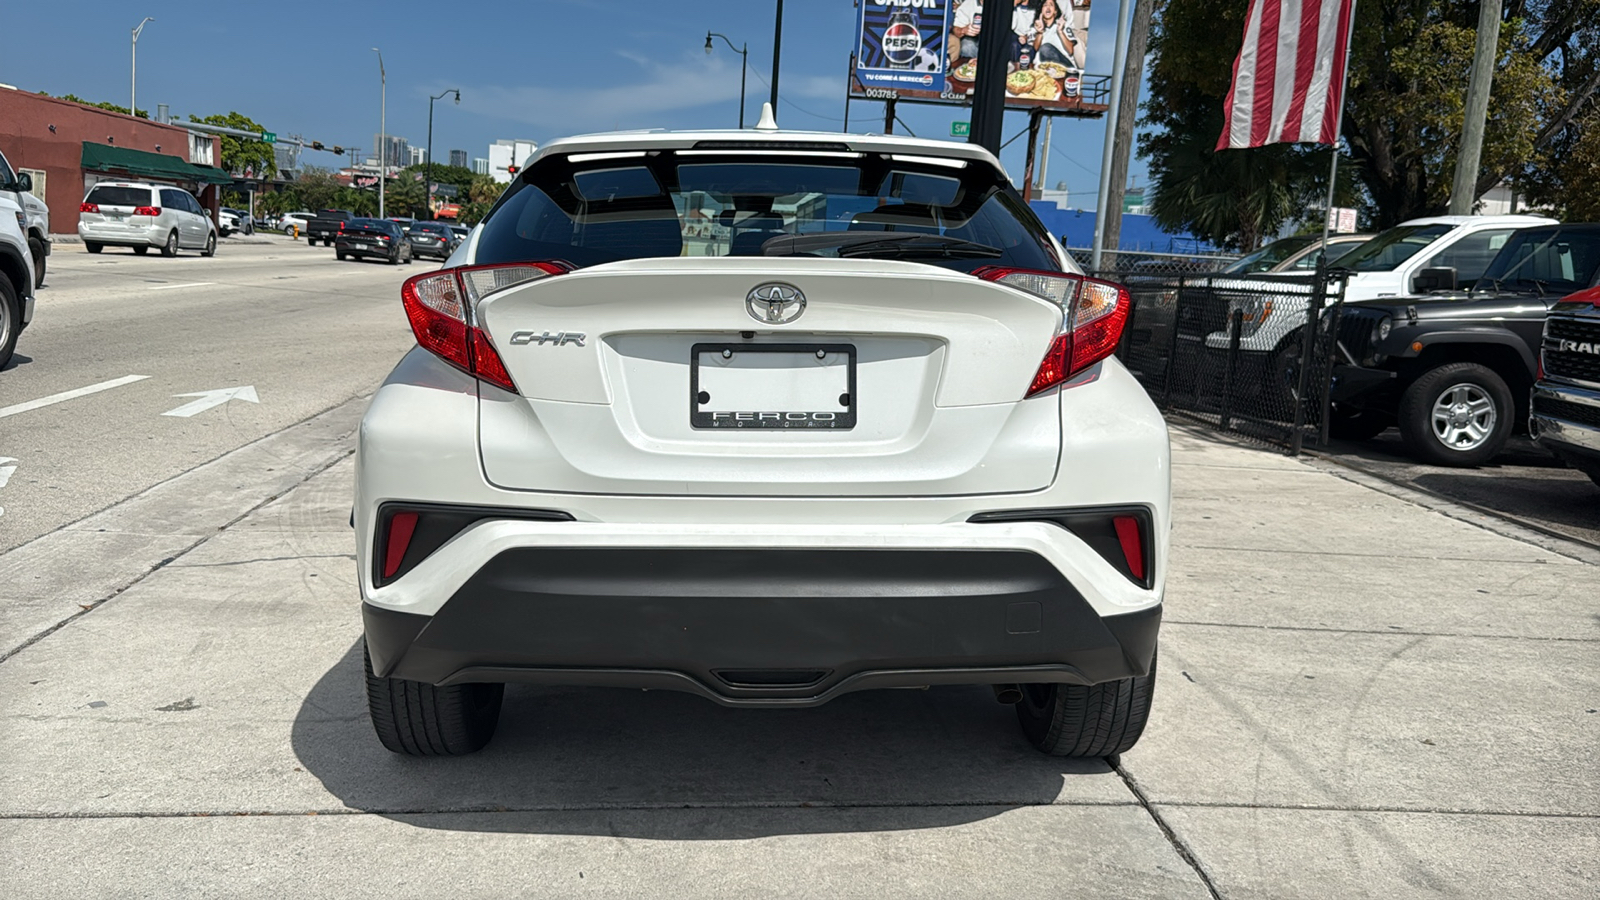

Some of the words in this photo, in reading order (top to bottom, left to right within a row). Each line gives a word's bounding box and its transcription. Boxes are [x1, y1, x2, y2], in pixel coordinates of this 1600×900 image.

[885, 38, 919, 48] PEPSI
[866, 89, 897, 99] 003785
[954, 124, 967, 133] SW
[510, 331, 586, 347] C-HR
[713, 412, 836, 420] FERCO
